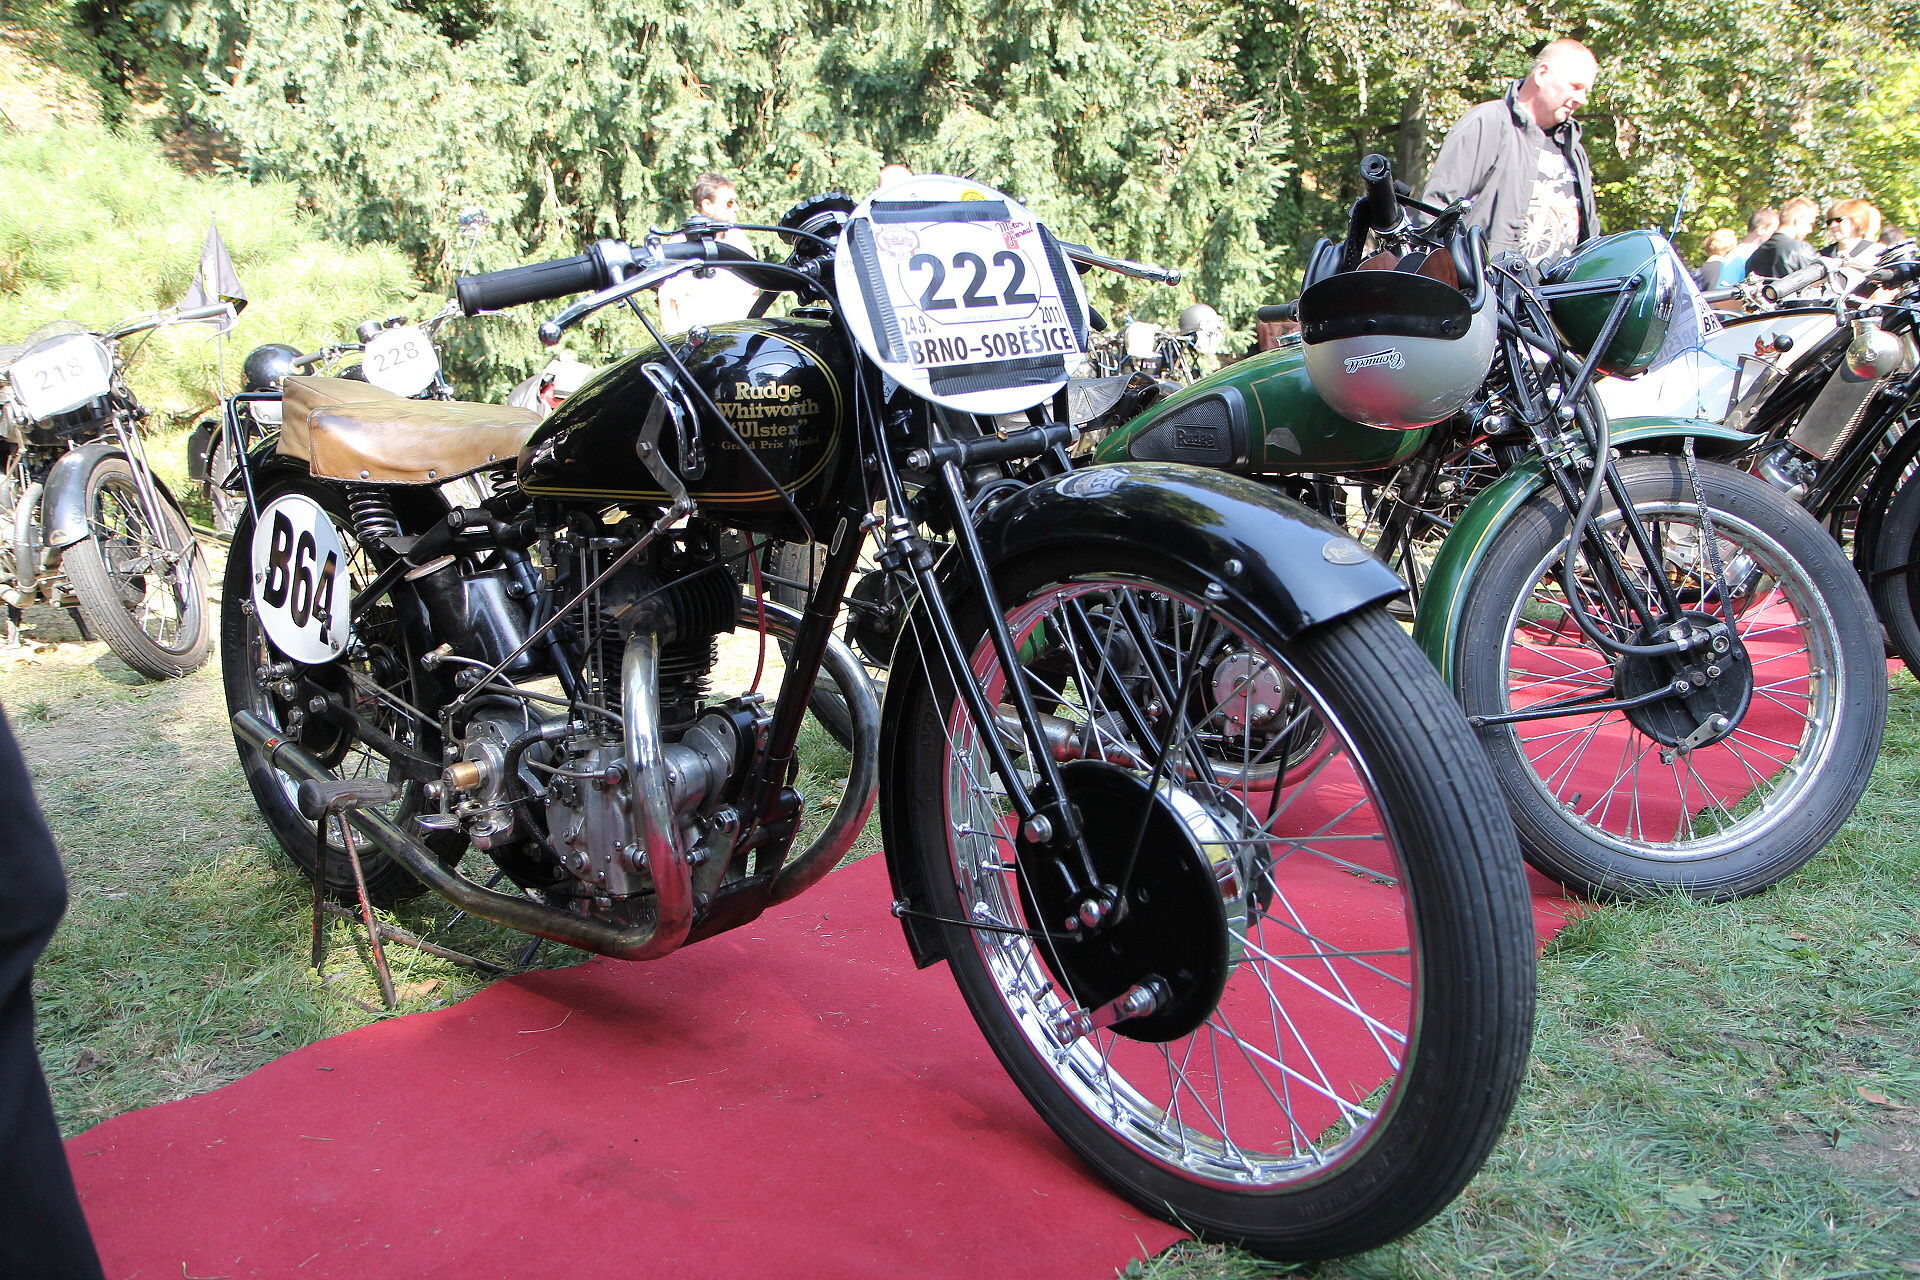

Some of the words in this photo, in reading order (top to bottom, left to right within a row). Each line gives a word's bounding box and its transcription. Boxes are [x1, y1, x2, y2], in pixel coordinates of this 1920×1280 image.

[908, 250, 1038, 312] 222
[900, 315, 932, 336] 24.9.
[1038, 305, 1064, 324] 2011
[373, 341, 420, 373] 228
[1344, 348, 1405, 374] Cromwell
[35, 356, 84, 391] 218
[735, 380, 802, 402] Rudge
[715, 399, 820, 419] Whitworth
[721, 440, 756, 450] Grad
[760, 439, 784, 449] Prix
[788, 435, 820, 448] Model
[1176, 428, 1215, 448] Rudge
[262, 508, 338, 646] B64
